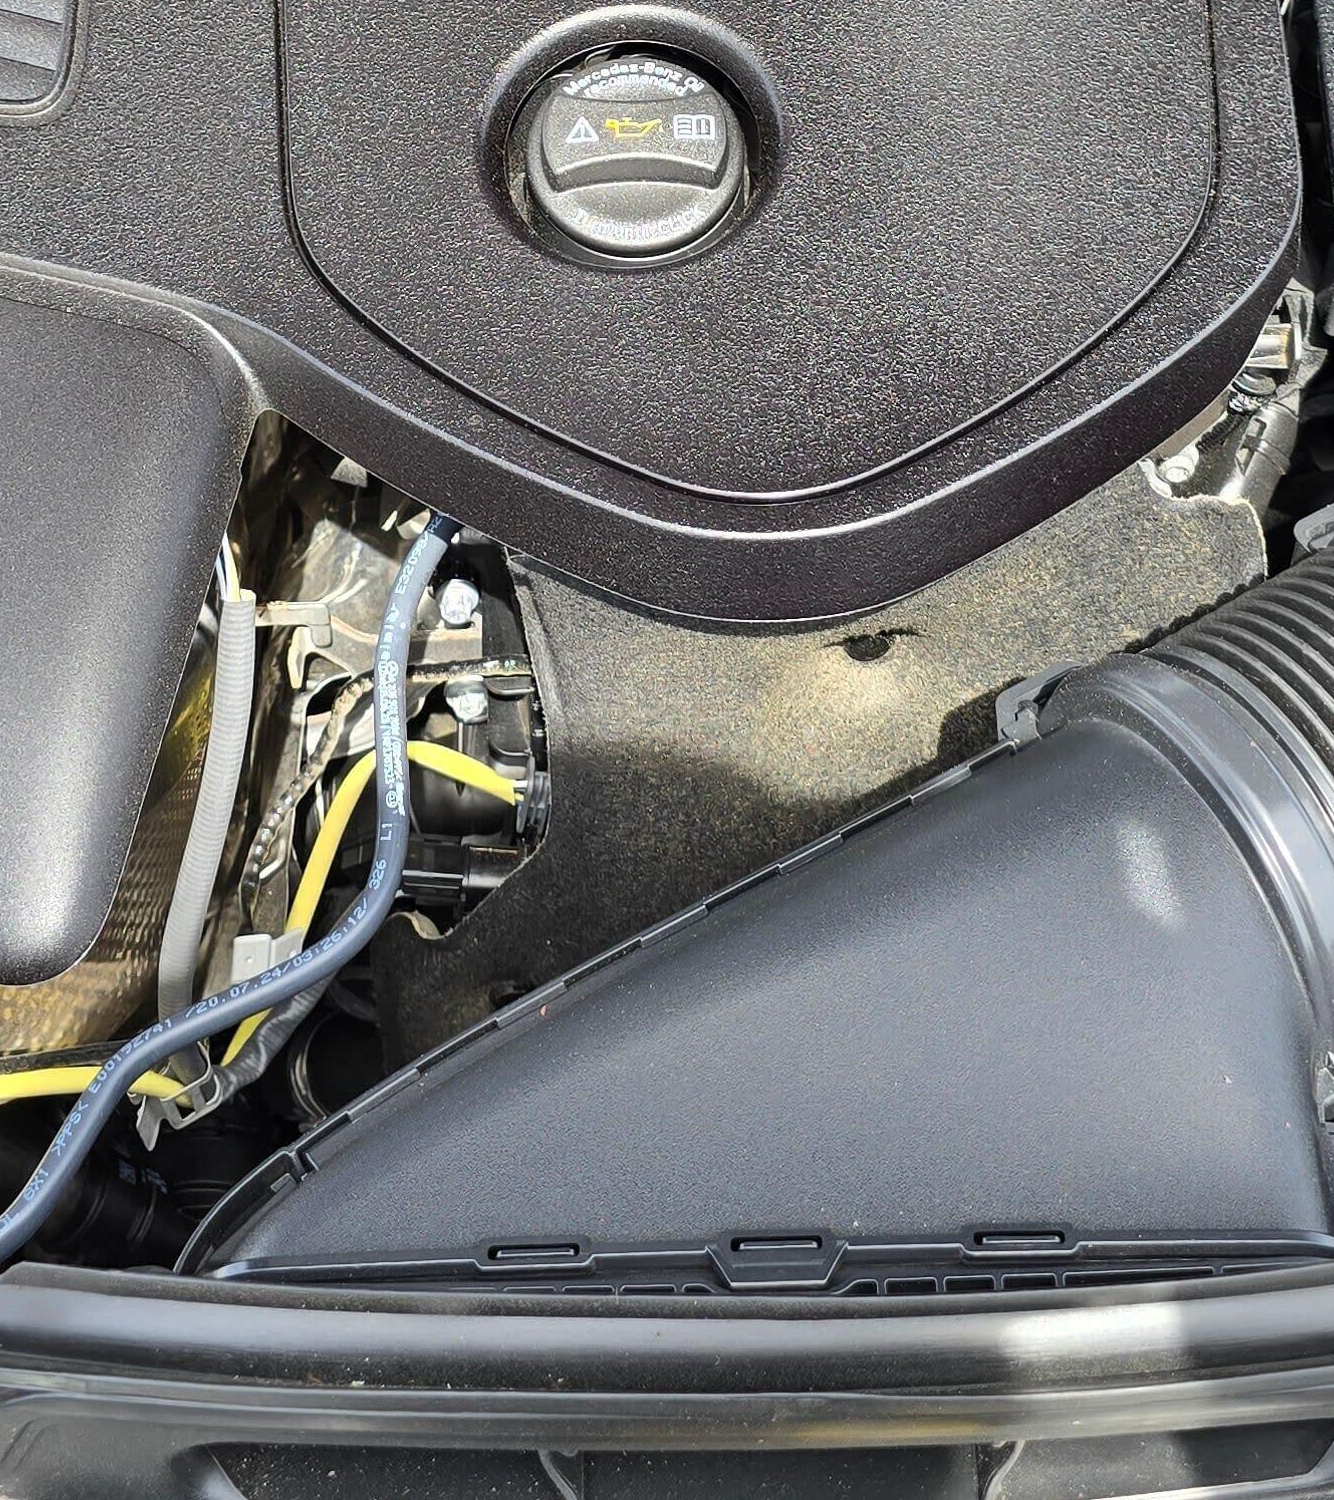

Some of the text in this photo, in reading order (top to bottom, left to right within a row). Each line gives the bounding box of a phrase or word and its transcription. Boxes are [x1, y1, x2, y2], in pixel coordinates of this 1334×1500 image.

[562, 61, 684, 96] Mercedes-Benz
[582, 74, 688, 99] recommended
[23, 1169, 50, 1202] 8X1
[368, 858, 387, 891] 326
[380, 822, 393, 841] L1
